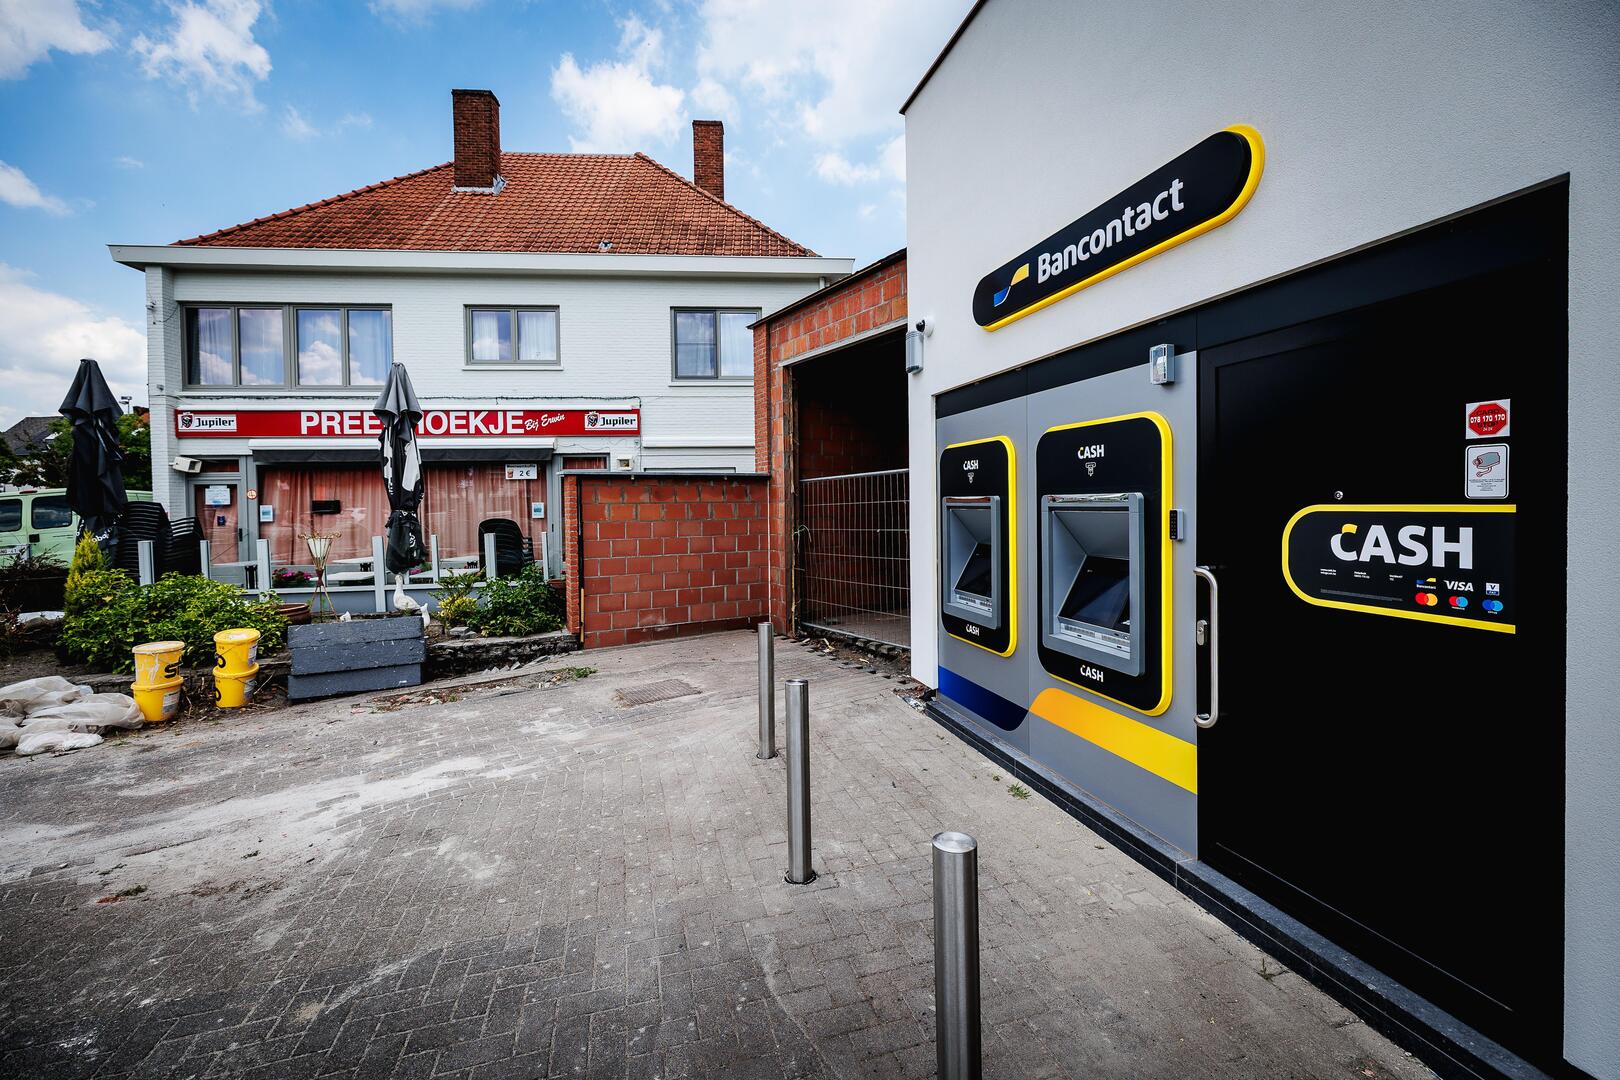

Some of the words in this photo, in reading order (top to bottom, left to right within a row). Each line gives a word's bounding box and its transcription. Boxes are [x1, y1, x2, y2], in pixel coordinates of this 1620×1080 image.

[1037, 178, 1185, 284] Bancontact
[195, 417, 235, 428] Jupiler
[524, 418, 539, 432] Bij
[540, 413, 566, 428] Erwin
[601, 416, 636, 428] Jupiler
[1470, 416, 1481, 424] 078
[1494, 413, 1506, 421] 170
[1077, 444, 1105, 460] CASH
[963, 459, 979, 471] CASH
[1330, 523, 1474, 570] CASH
[1444, 580, 1474, 592] VISA
[965, 623, 980, 637] CASH
[1080, 664, 1104, 683] CASH
